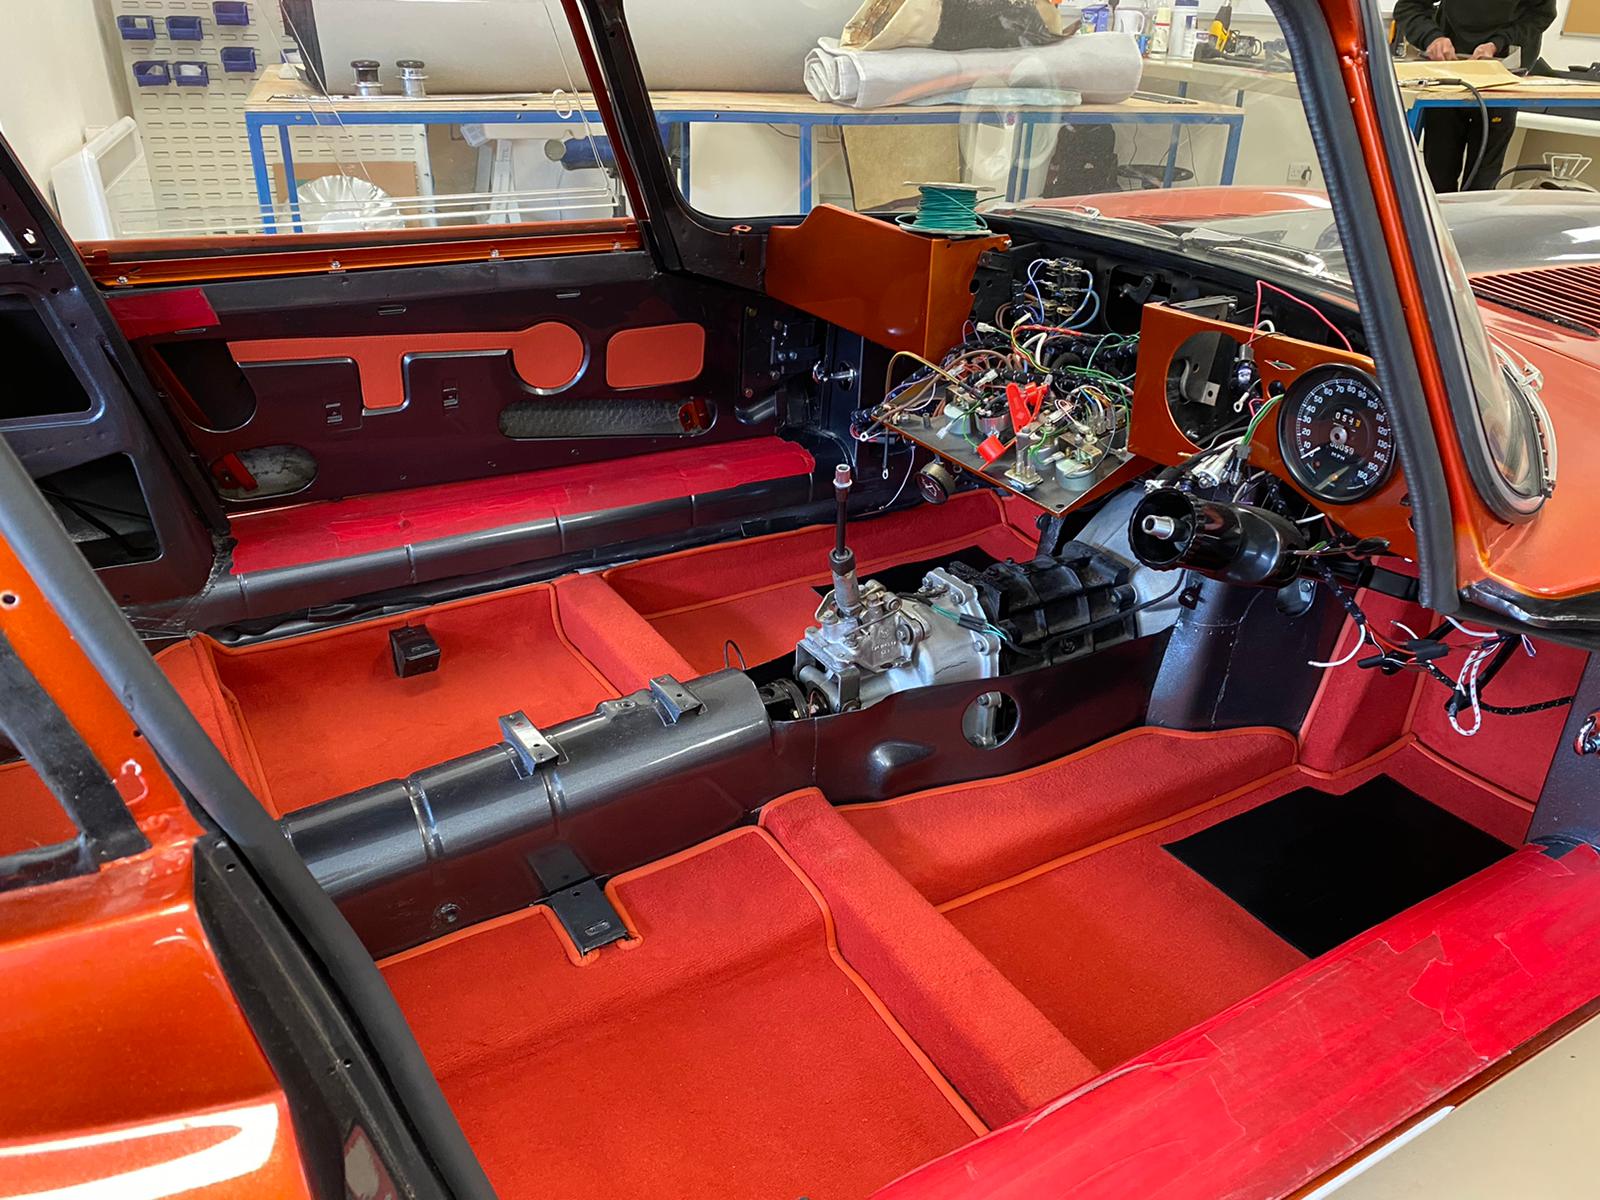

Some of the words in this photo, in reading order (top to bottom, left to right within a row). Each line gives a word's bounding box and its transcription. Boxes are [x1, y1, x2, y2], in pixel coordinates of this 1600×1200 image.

[1324, 387, 1333, 396] 60
[1336, 385, 1345, 393] 70
[1347, 385, 1356, 394] 80
[1357, 390, 1367, 399] 90
[1314, 395, 1323, 404] 50
[1306, 404, 1316, 413] 40
[1367, 400, 1378, 410] 100
[1302, 415, 1312, 424] 30
[1301, 428, 1311, 436] 20
[1377, 426, 1388, 436] 120
[1303, 441, 1311, 449] 10
[1377, 439, 1388, 449] 130
[1331, 451, 1346, 461] MPH
[1373, 450, 1385, 461] 140
[1367, 461, 1379, 472] 150
[1357, 470, 1368, 480] 160
